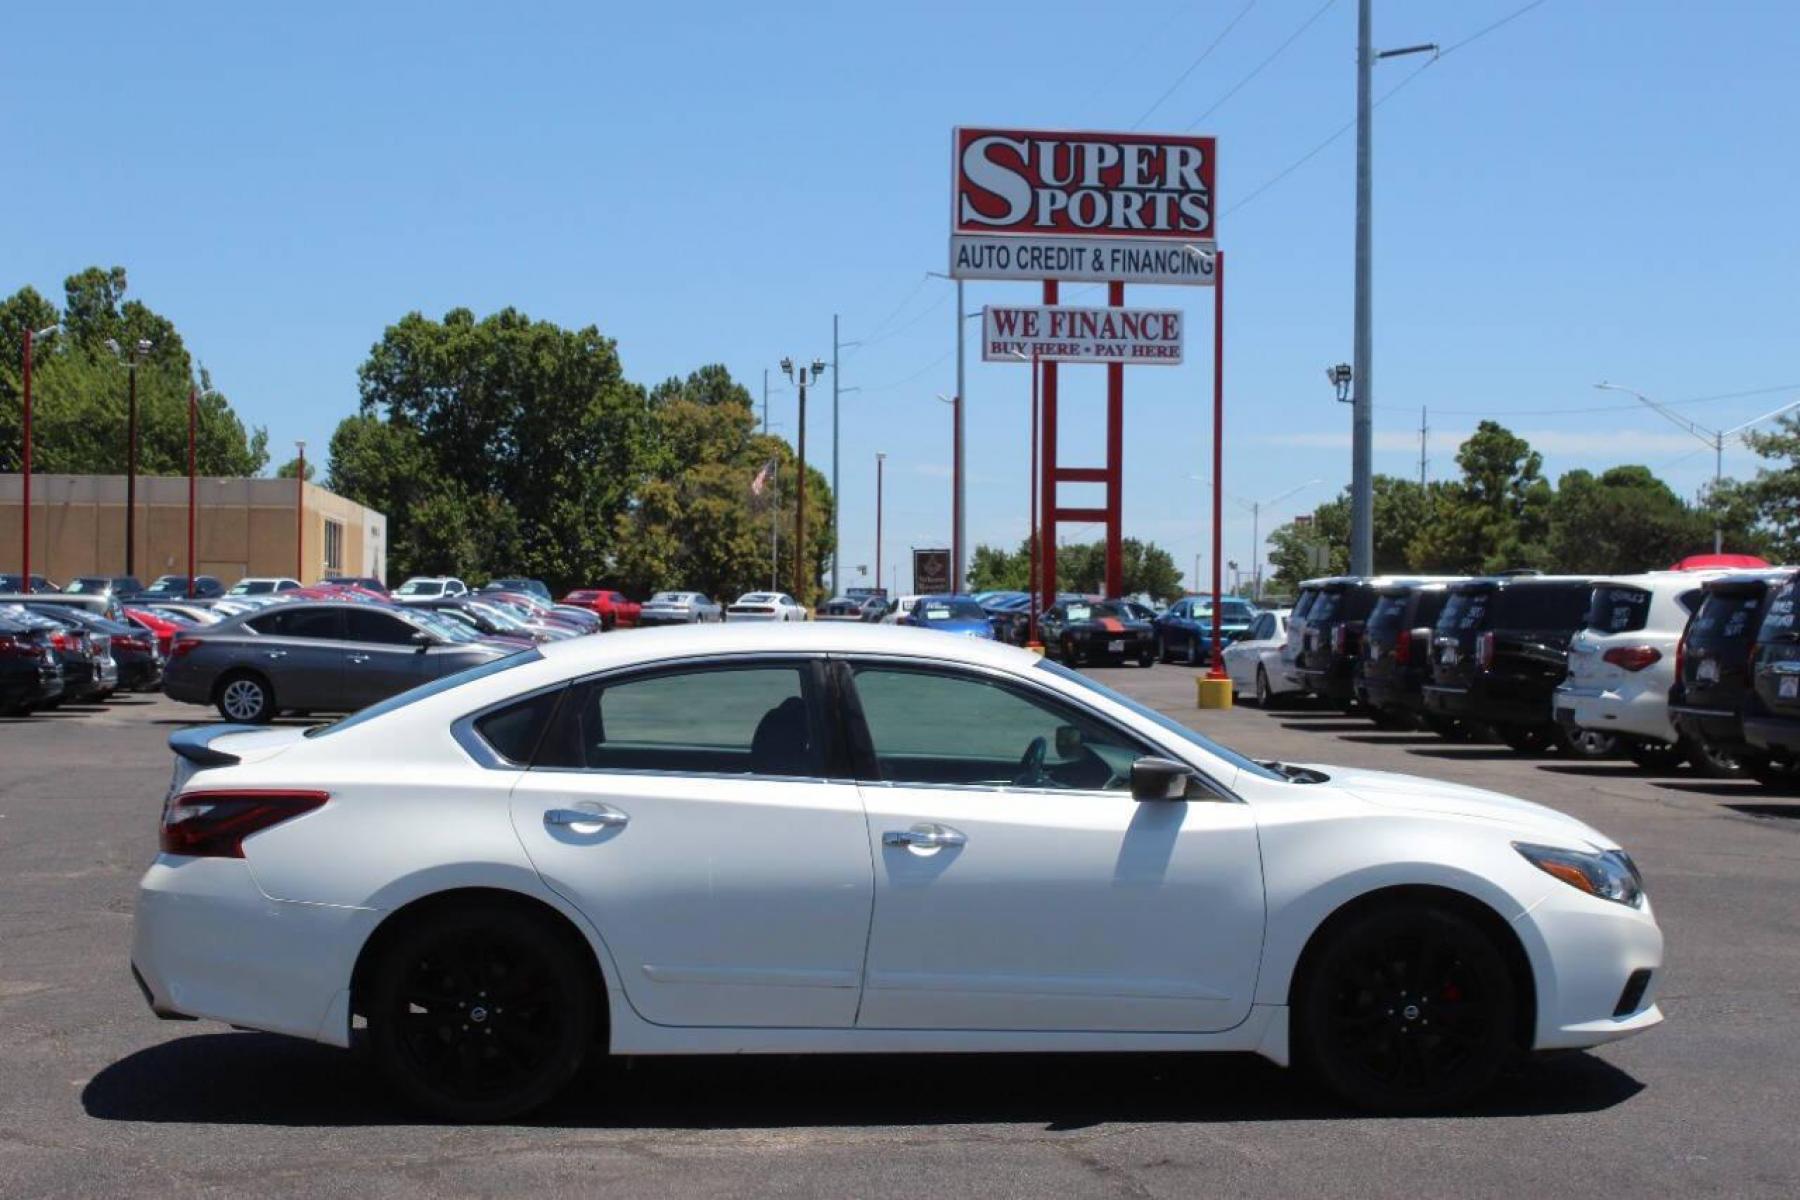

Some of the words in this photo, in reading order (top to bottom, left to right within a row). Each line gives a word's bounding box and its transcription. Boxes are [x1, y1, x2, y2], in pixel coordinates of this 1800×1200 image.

[962, 136, 1208, 226] SUPER
[957, 244, 1010, 269] AUTO
[1017, 246, 1087, 271] CREDIT
[1092, 248, 1104, 272] &
[1111, 248, 1213, 275] FINANCING
[992, 310, 1039, 338] WE
[1049, 311, 1179, 341] FINANCE
[991, 341, 1027, 354] BUY
[1031, 342, 1081, 355] HERE
[1095, 344, 1126, 357] PAY
[1131, 345, 1180, 358] HERE
